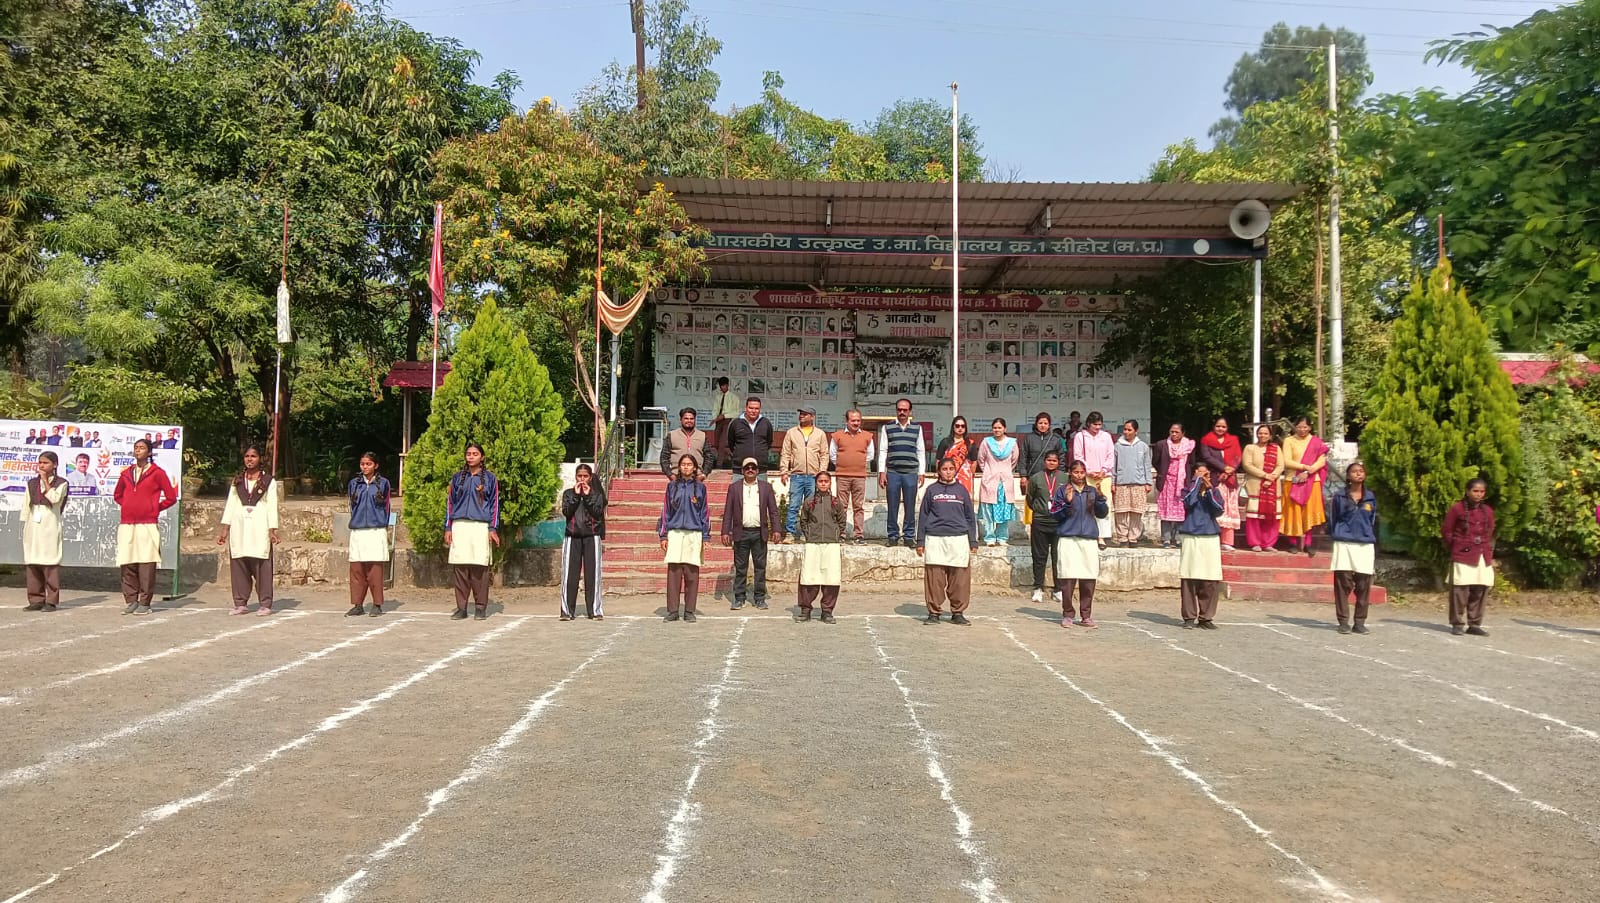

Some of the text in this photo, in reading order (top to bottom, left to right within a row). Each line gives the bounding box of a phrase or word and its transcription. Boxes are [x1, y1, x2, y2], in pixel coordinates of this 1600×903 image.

[706, 233, 792, 249] शासकीय
[798, 237, 866, 253] उत्कृष्ट
[1050, 237, 1110, 253] सीहोर
[769, 292, 811, 305] शासकीय
[848, 296, 879, 306] उच्चतर
[882, 294, 928, 307] माध्यमिक
[930, 295, 972, 307] विद्याय
[933, 493, 956, 501] adidas
